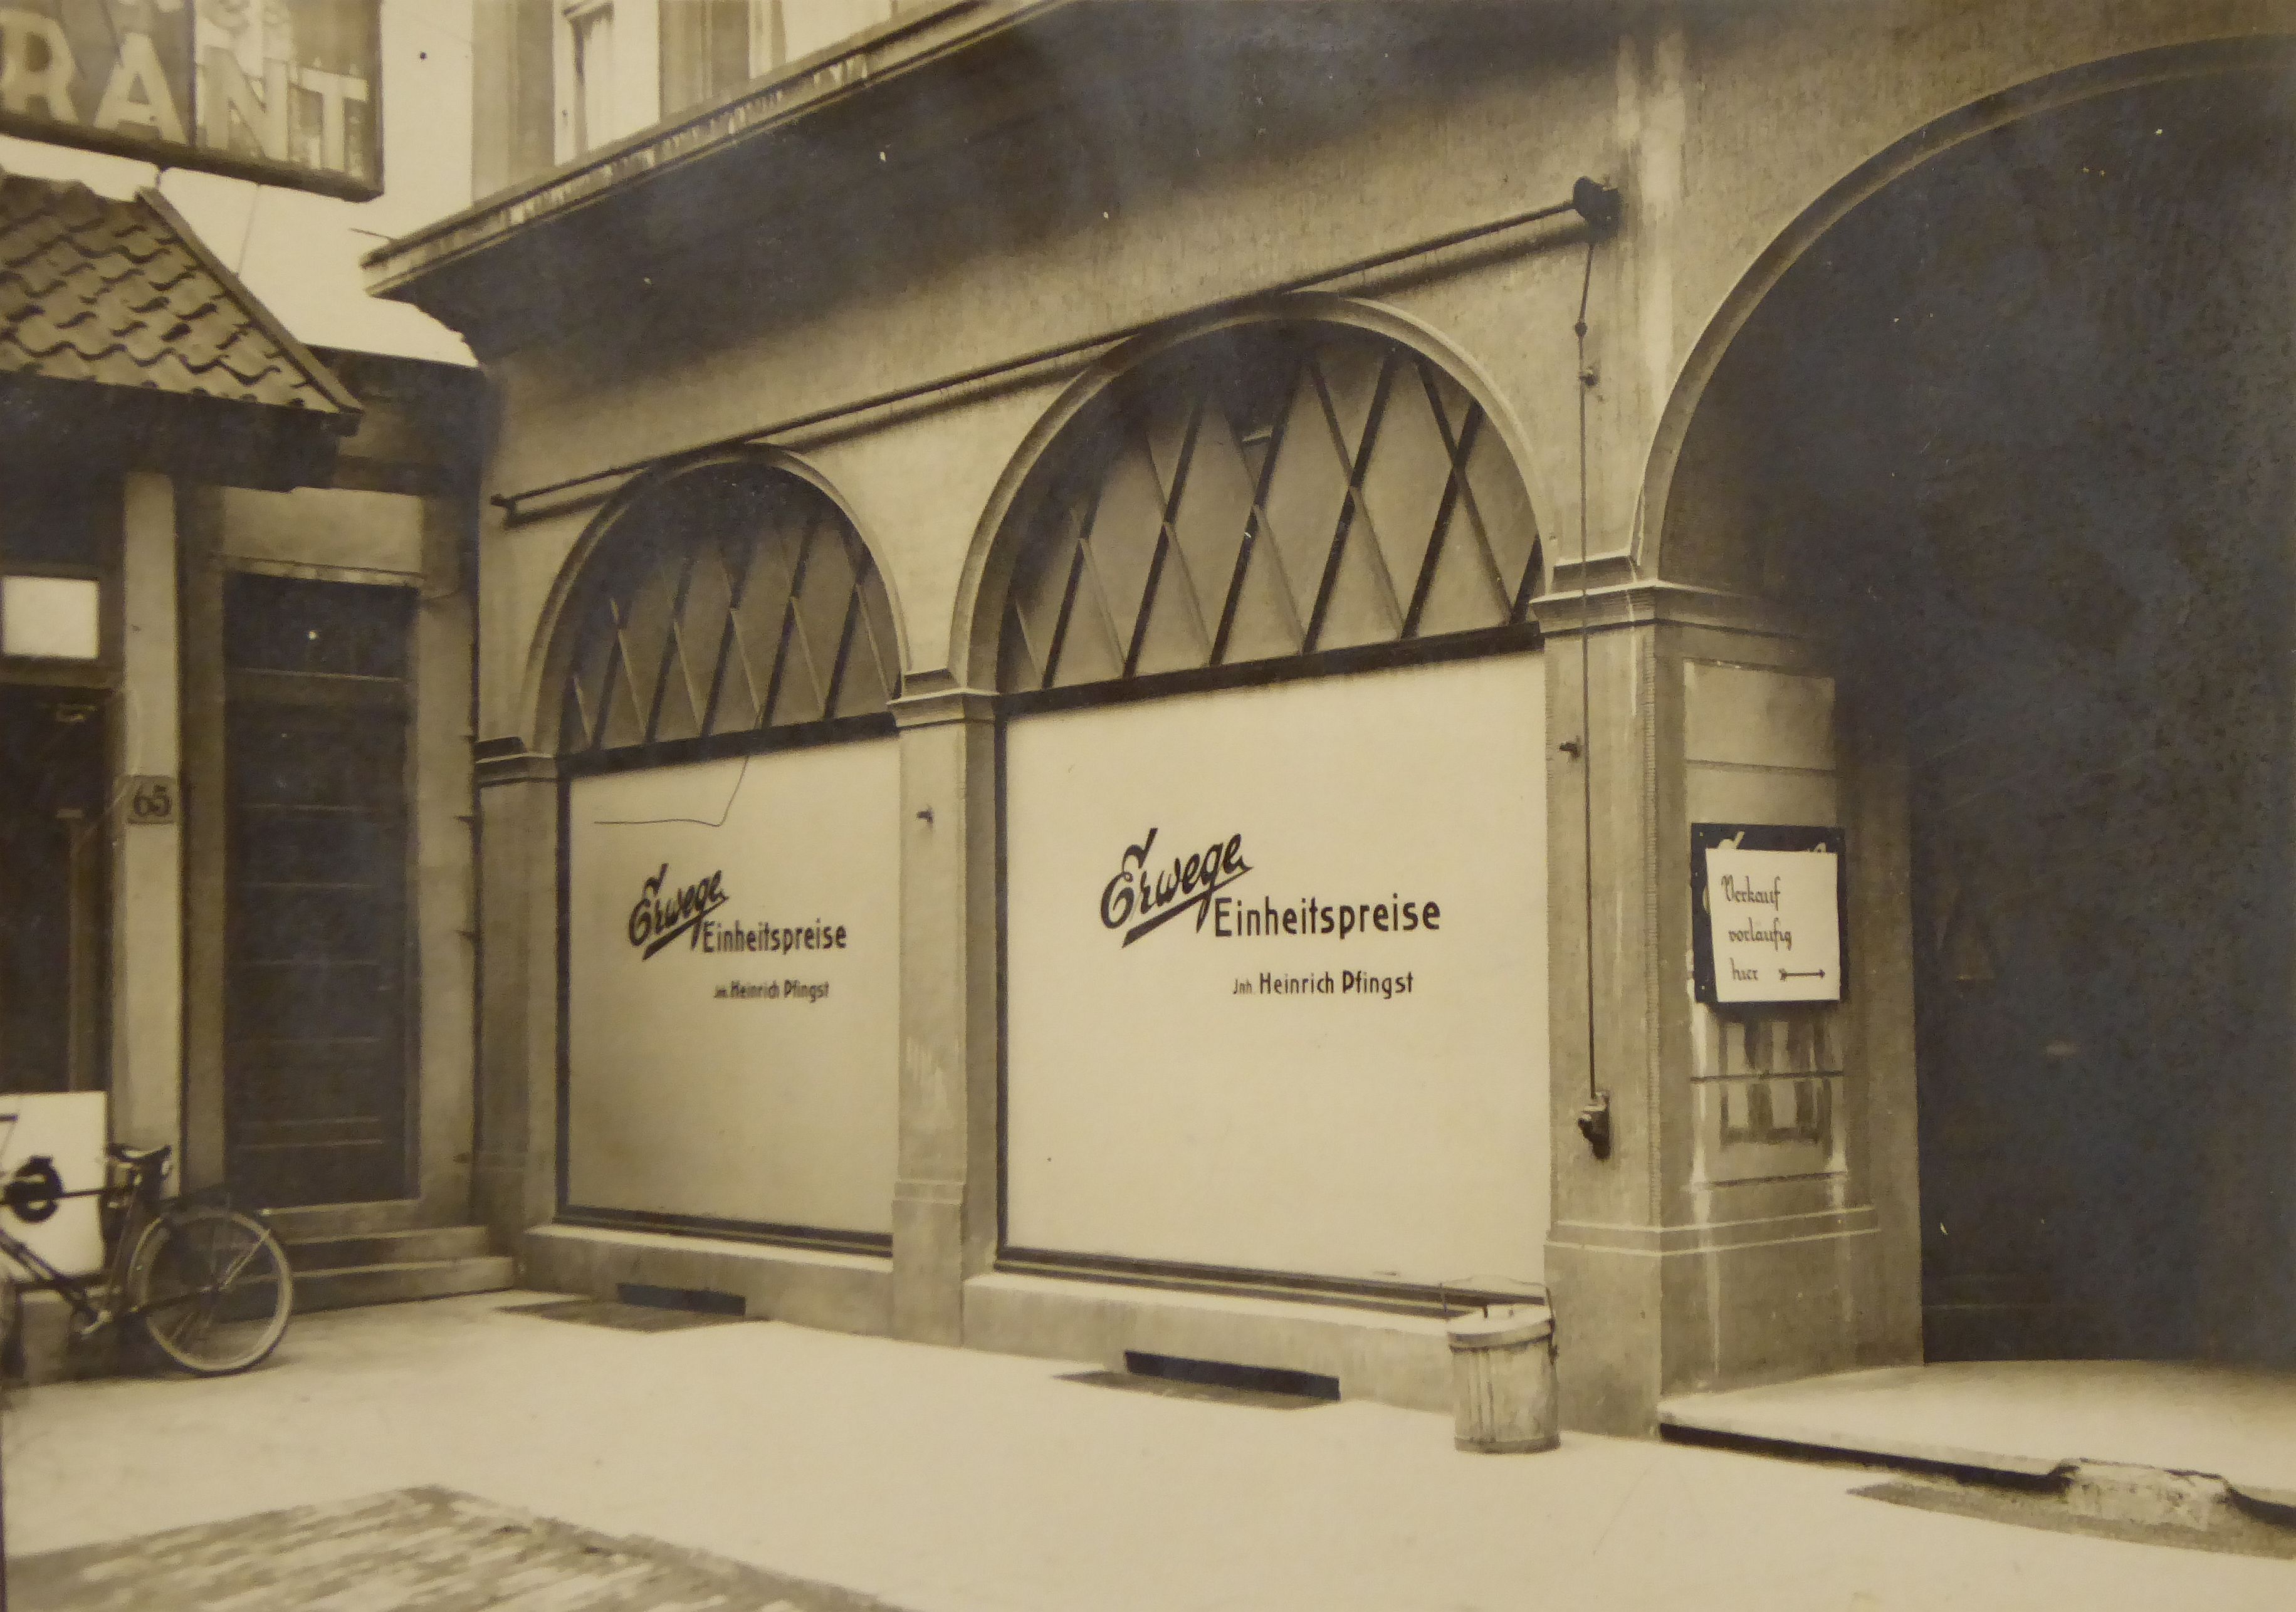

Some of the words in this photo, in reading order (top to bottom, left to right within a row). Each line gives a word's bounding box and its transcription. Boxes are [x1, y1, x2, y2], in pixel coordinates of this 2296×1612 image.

[0, 8, 369, 173] RANT
[1100, 827, 1254, 948] Erwege
[1721, 874, 1781, 911] Verkauf
[703, 917, 847, 955] Einheitspreise
[1215, 893, 1441, 940] Einheitspreise
[1259, 971, 1334, 995] Heinrich
[1342, 970, 1414, 1000] Pfingst
